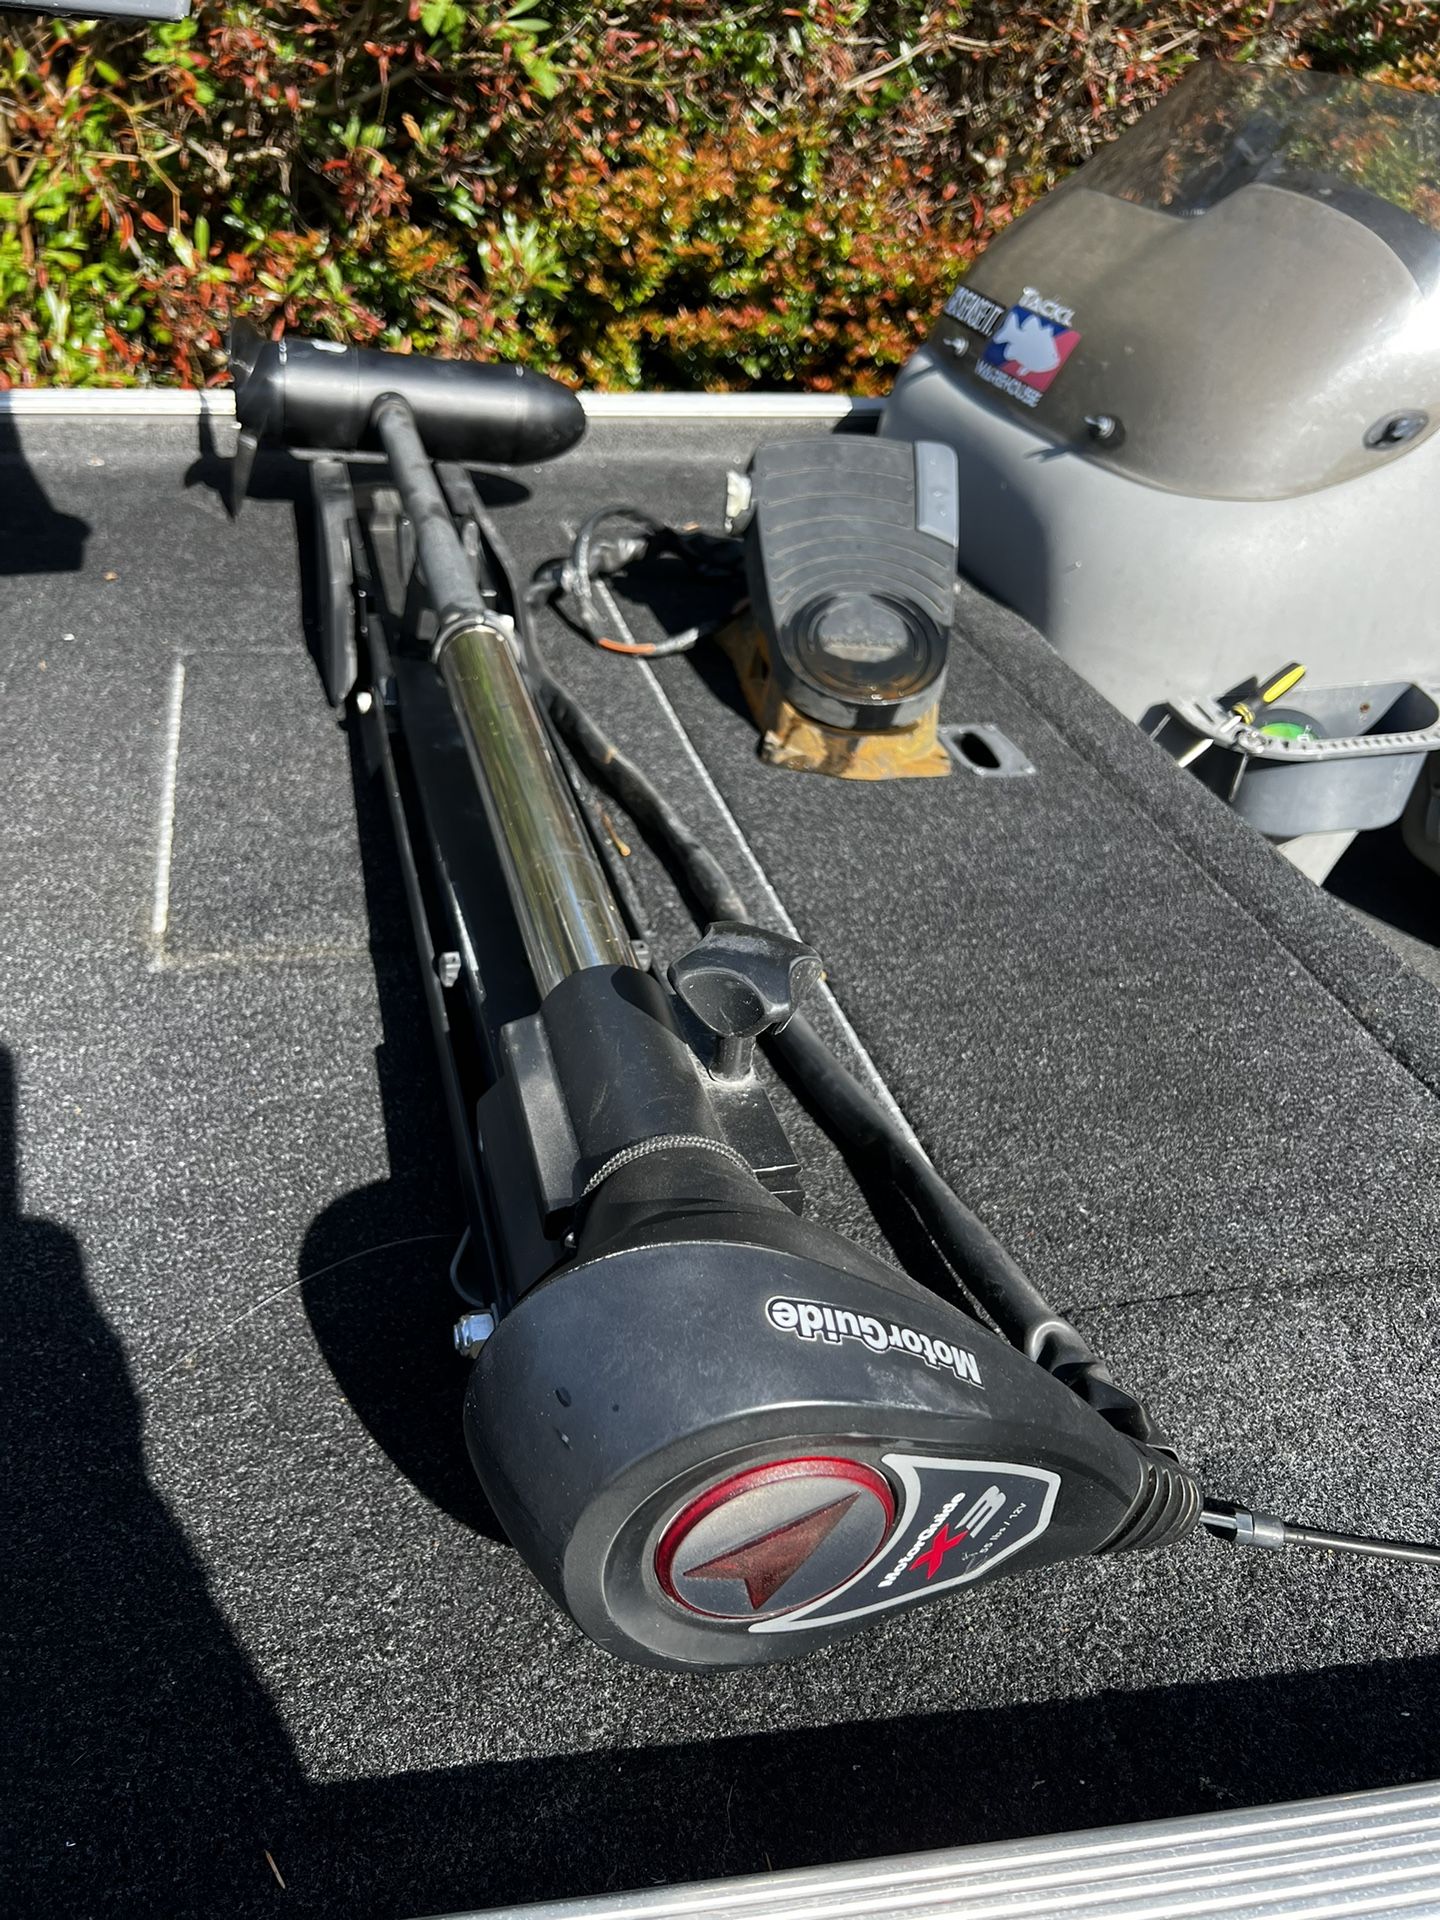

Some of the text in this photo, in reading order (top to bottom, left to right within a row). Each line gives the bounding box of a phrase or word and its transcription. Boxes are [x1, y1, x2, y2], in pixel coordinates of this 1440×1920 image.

[768, 1299, 984, 1387] MotorGuide
[878, 1492, 966, 1588] MotorGuide
[1009, 1502, 1027, 1519] 12V
